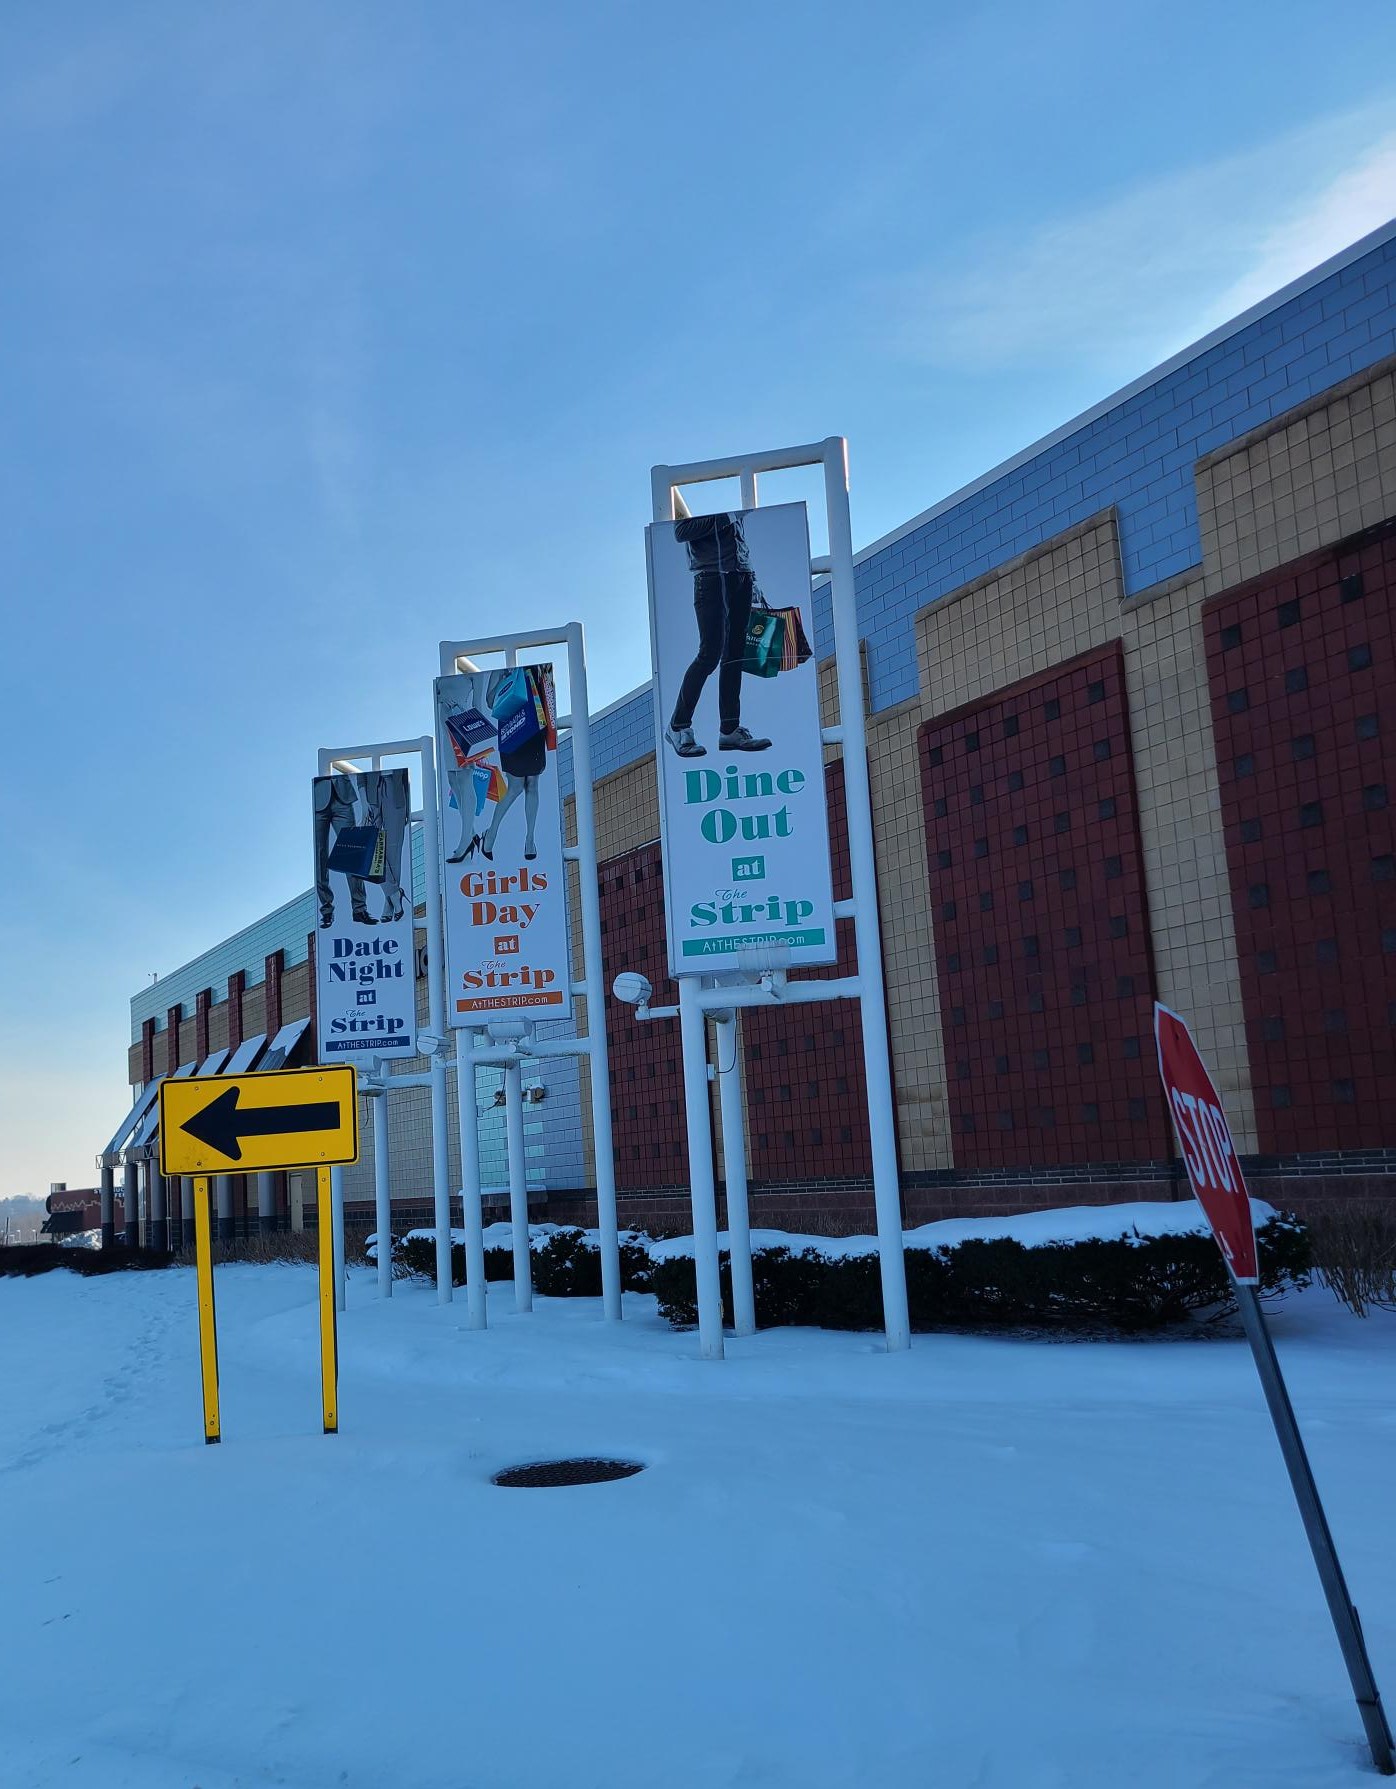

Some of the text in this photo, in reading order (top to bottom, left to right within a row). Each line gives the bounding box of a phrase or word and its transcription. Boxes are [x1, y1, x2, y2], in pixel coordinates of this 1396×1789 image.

[682, 765, 805, 805] Dine
[700, 804, 795, 844] Out
[736, 859, 762, 877] at
[460, 867, 548, 898] Girls
[715, 888, 748, 901] The
[470, 901, 541, 930] Day
[691, 896, 814, 929] Strip
[331, 936, 399, 959] Date
[497, 937, 517, 951] at
[328, 958, 405, 986] Night
[481, 959, 506, 970] The
[462, 965, 555, 990] Strip
[358, 992, 374, 1003] at
[330, 1014, 404, 1034] Strip
[345, 1008, 366, 1018] The
[1171, 1086, 1240, 1194] STOP
